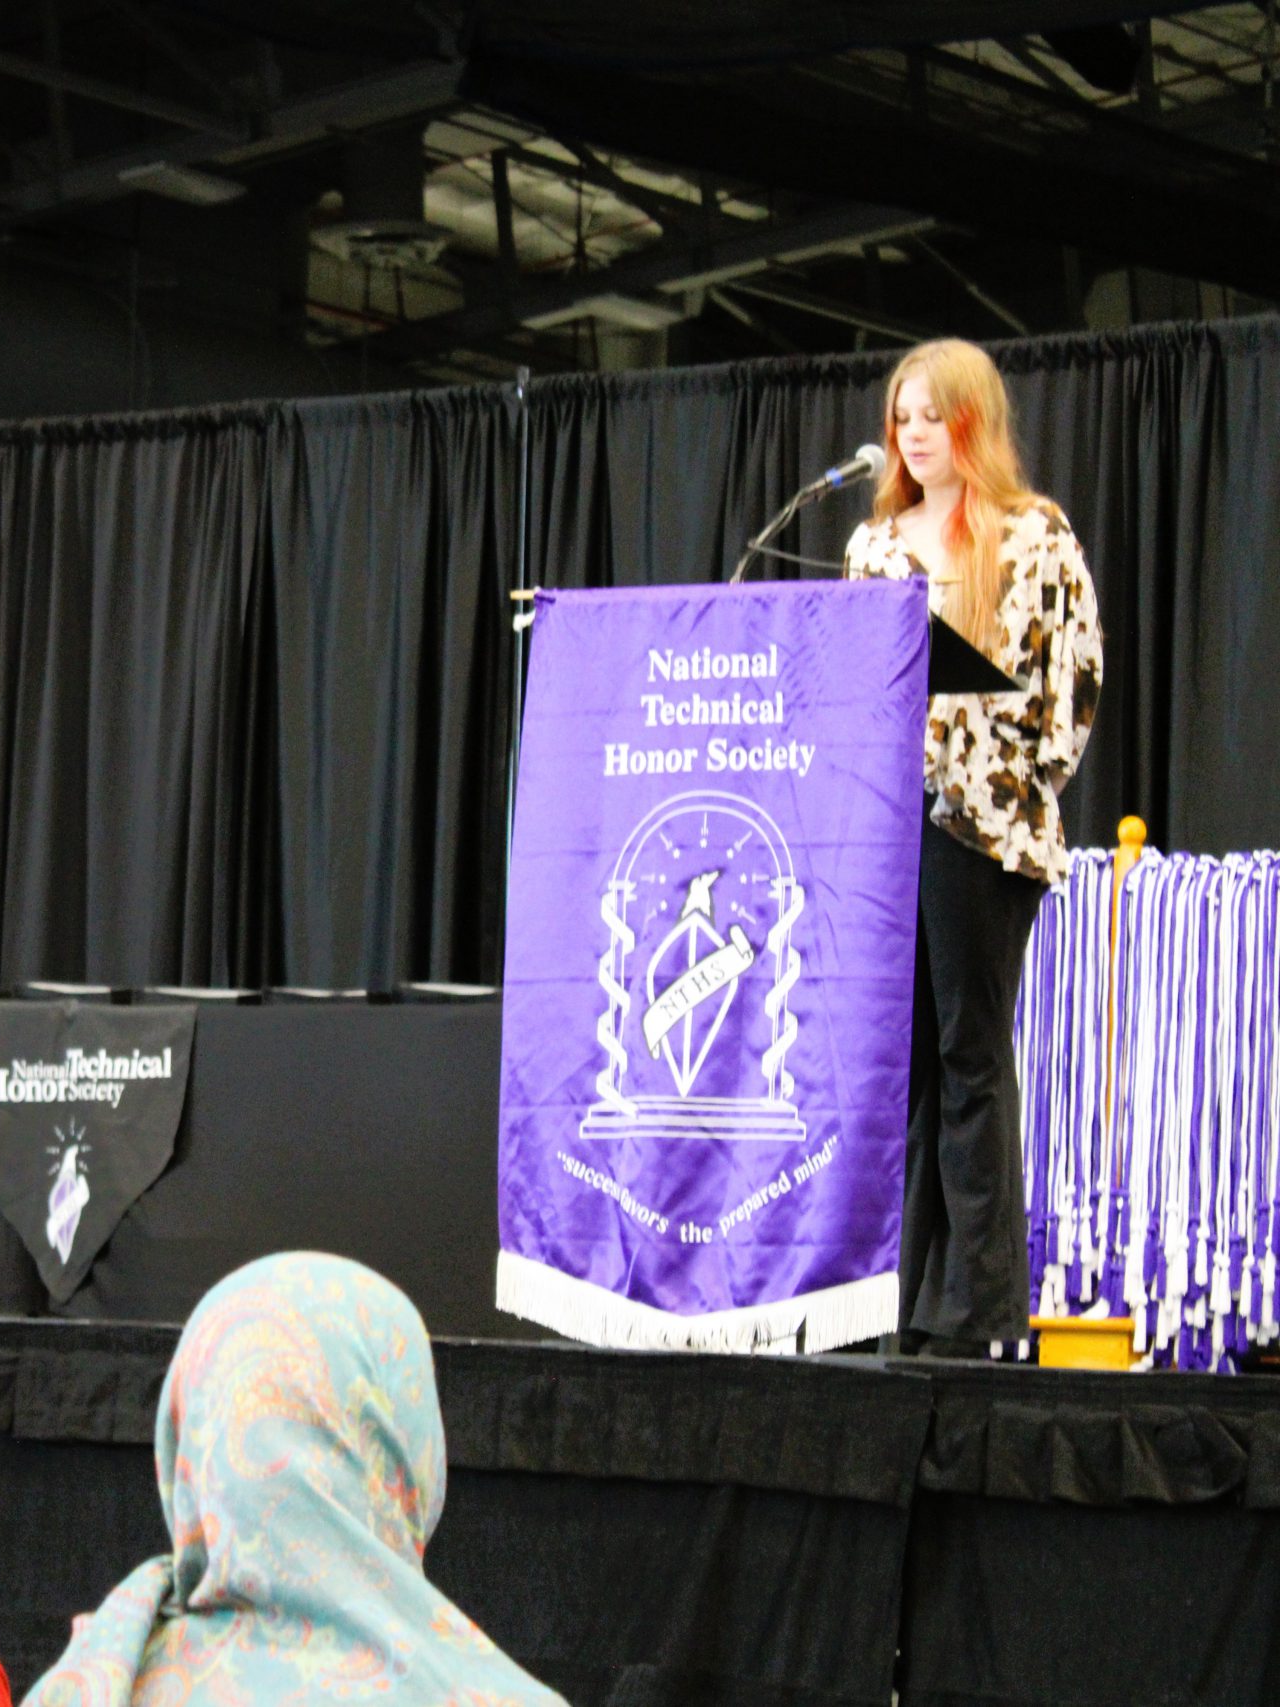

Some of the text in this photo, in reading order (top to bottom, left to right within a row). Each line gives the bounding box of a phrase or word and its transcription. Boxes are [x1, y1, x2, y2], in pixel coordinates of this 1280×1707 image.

[647, 643, 778, 682] National
[640, 691, 784, 727] Technical
[603, 737, 816, 778] Honor Society
[659, 962, 725, 1019] NTHS
[66, 1047, 172, 1080] Technical
[680, 1221, 713, 1243] the
[719, 1170, 792, 1238] prepared
